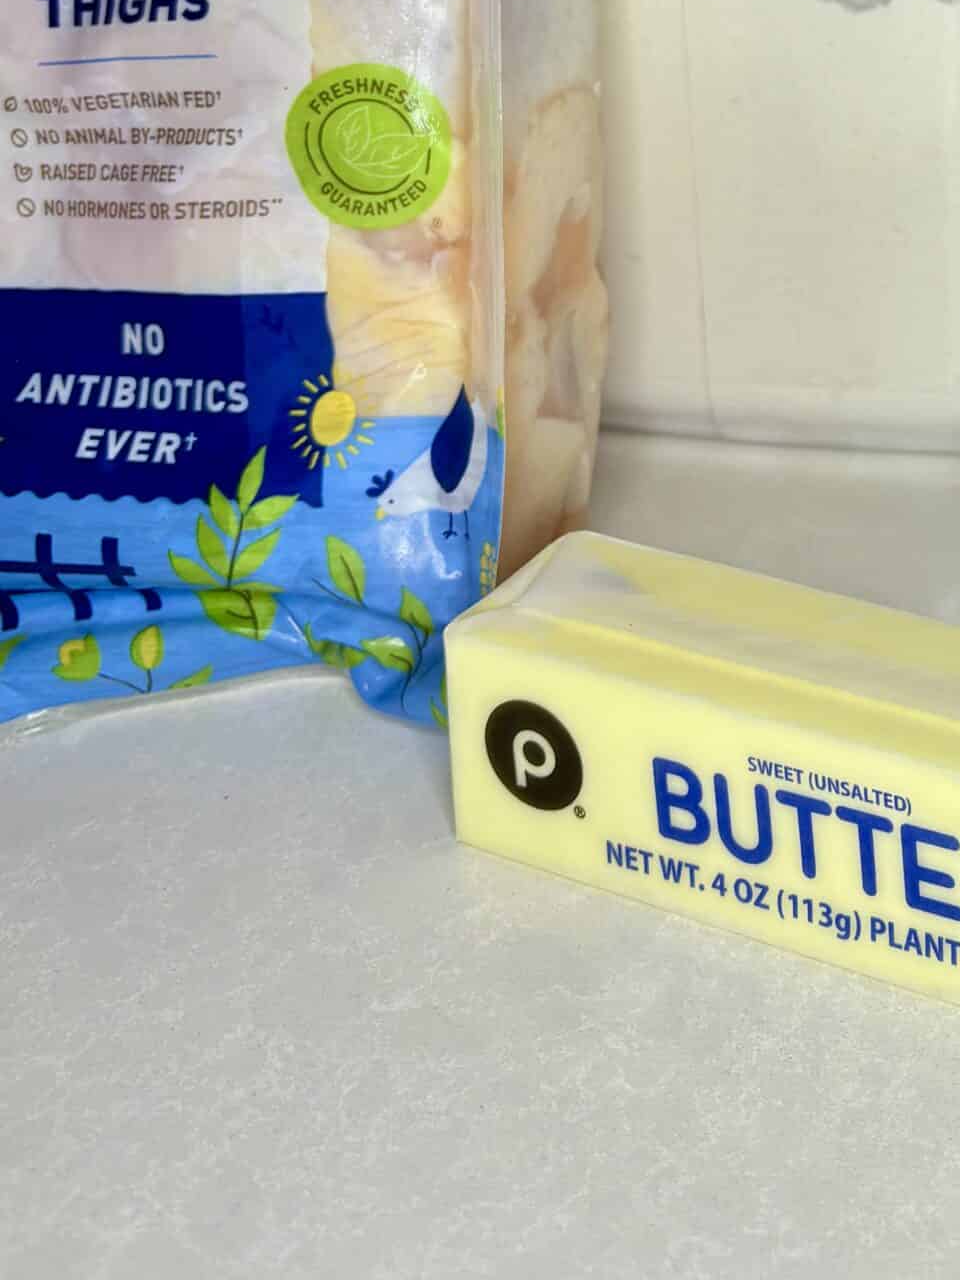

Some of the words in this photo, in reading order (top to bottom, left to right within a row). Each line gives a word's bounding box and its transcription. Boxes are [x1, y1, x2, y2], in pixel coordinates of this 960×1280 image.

[24, 98, 69, 114] 100%
[71, 91, 180, 112] VEGETARIAN
[309, 77, 420, 115] FRESHNESS
[36, 129, 60, 145] NO
[65, 128, 126, 145] ANIMAL
[40, 163, 97, 182] RAISED
[100, 164, 138, 182] CAGE
[43, 200, 64, 216] NO
[68, 200, 146, 220] HORMONES
[150, 203, 171, 220] OR
[320, 179, 428, 217] GUARANTEED
[122, 322, 165, 356] NO
[15, 372, 249, 414] ANTIBIOTICS
[747, 756, 804, 785] SWEET
[808, 771, 912, 816] (UNSALTED)
[606, 839, 654, 875] NET
[659, 855, 705, 892] WT.
[711, 872, 728, 897] 4
[733, 878, 770, 910] OZ
[777, 888, 862, 942] (113g)
